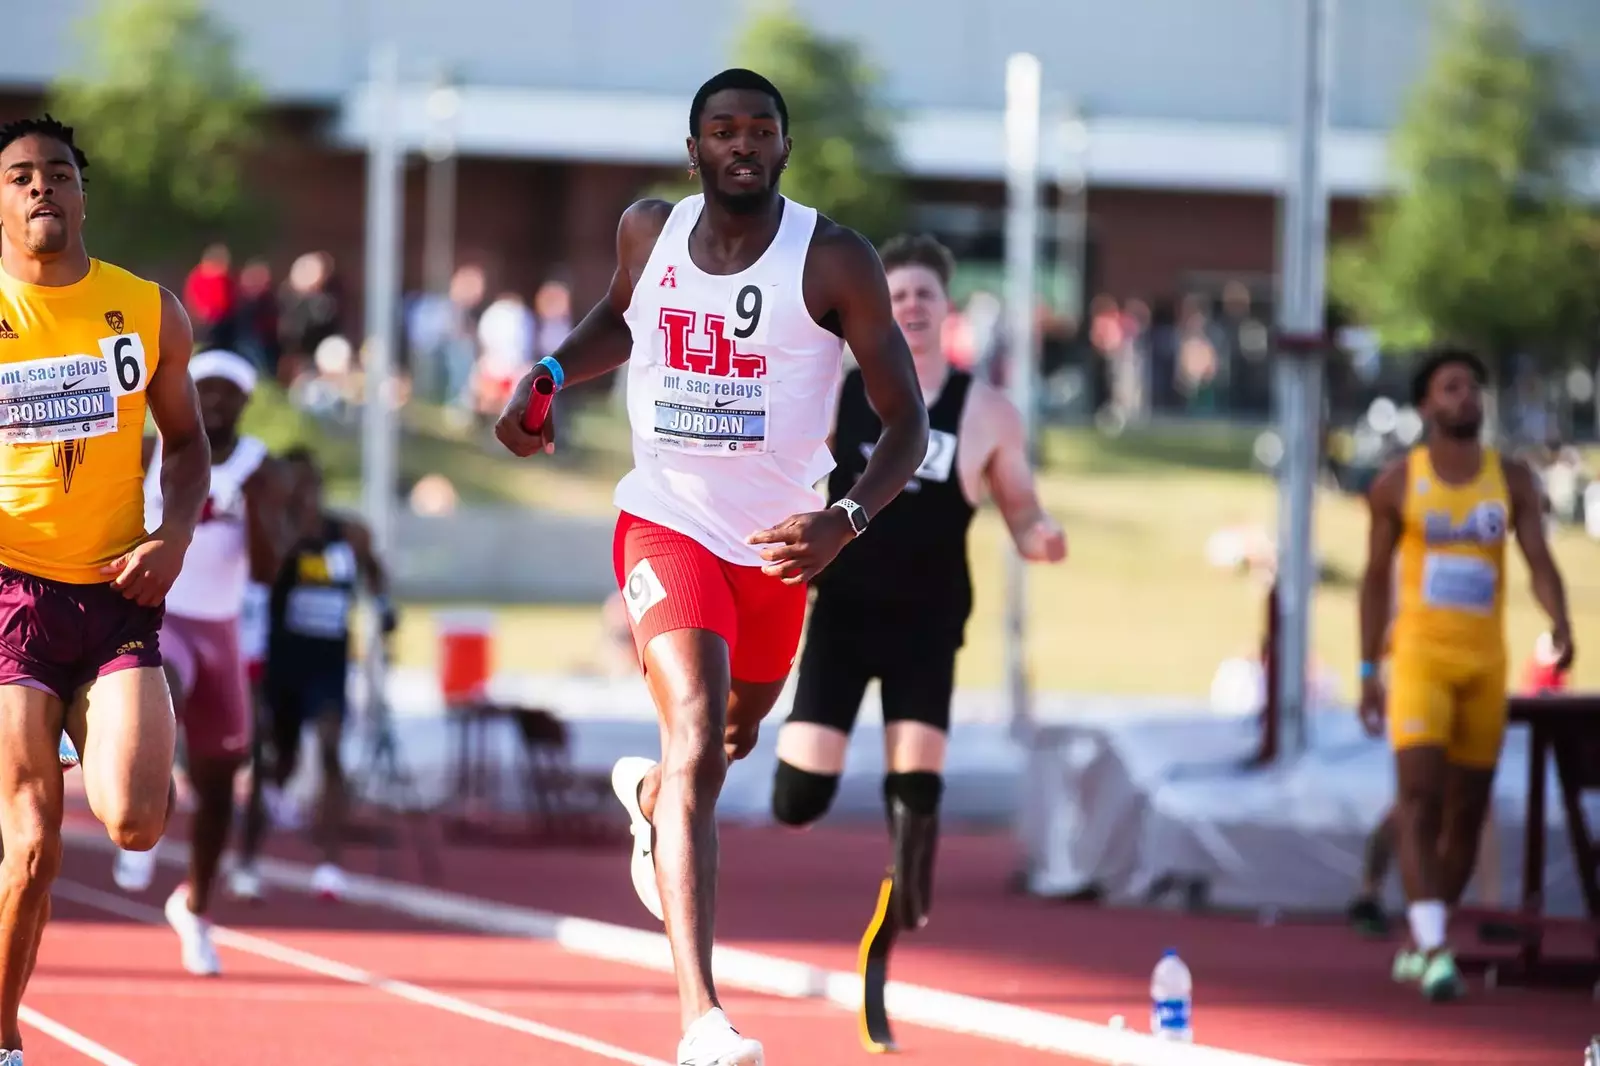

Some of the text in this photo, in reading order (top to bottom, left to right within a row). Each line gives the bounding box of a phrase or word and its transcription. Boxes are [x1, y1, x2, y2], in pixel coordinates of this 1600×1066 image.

[733, 284, 763, 339] 9
[1, 360, 108, 386] mt. sac relays
[113, 337, 141, 392] 6
[663, 374, 763, 398] mt. sac relays
[7, 394, 105, 422] ROBINSON
[669, 411, 745, 434] JORDAN
[628, 571, 652, 613] 9
